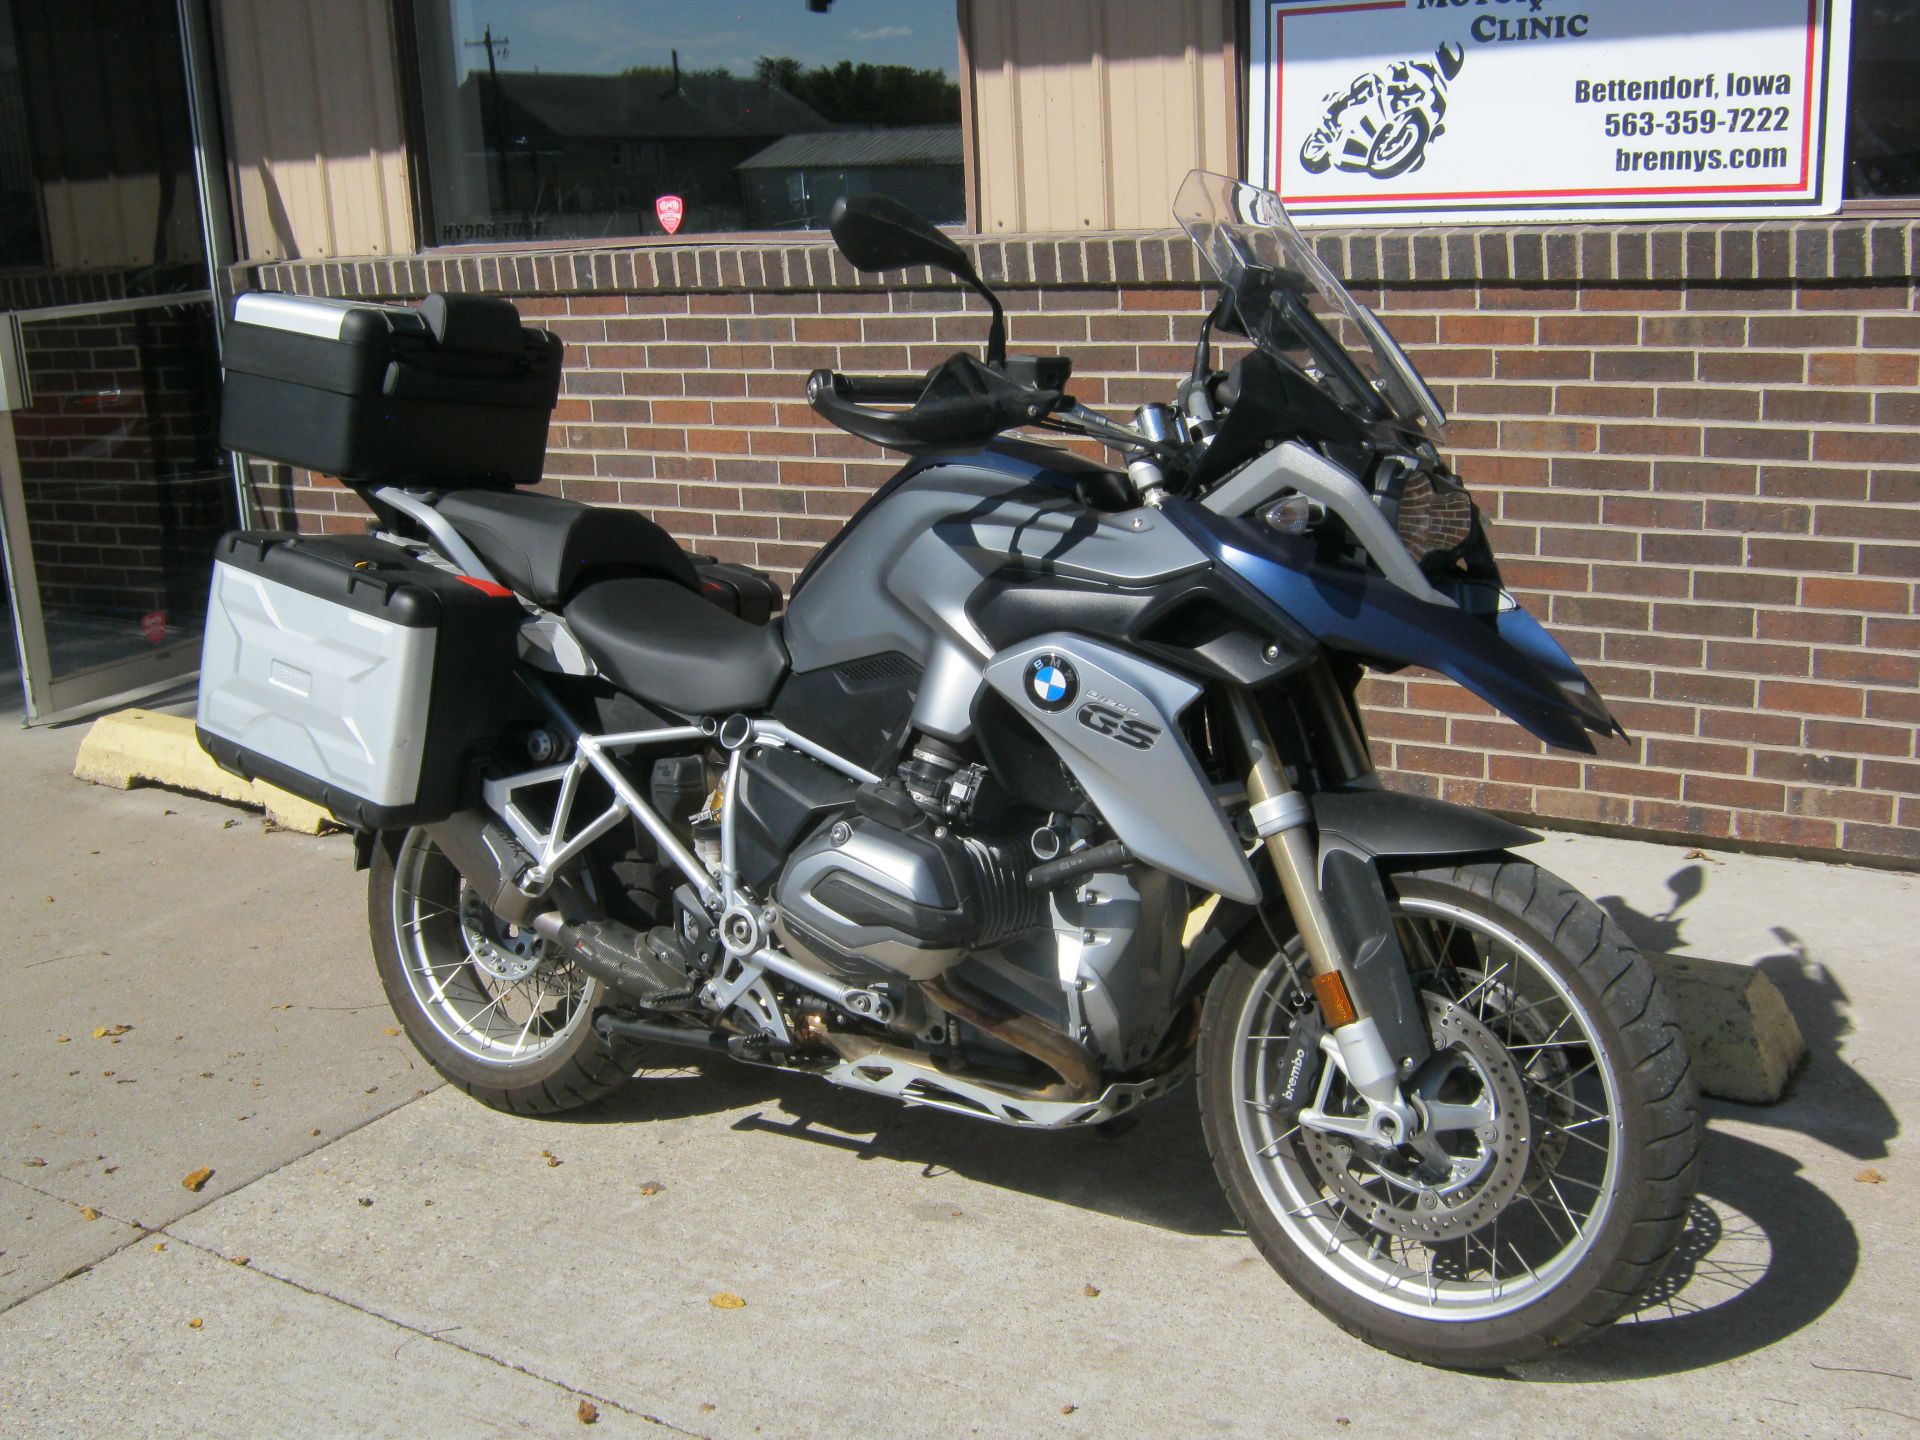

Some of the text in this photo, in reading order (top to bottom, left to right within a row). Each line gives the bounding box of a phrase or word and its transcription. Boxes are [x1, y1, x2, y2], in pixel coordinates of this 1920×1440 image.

[1575, 73, 1791, 103] Bettendorf, Iowa
[1605, 106, 1790, 137] 563-359-7222
[1615, 147, 1788, 172] brennys.com
[1076, 702, 1162, 751] GS
[1282, 1049, 1305, 1100] brembo
